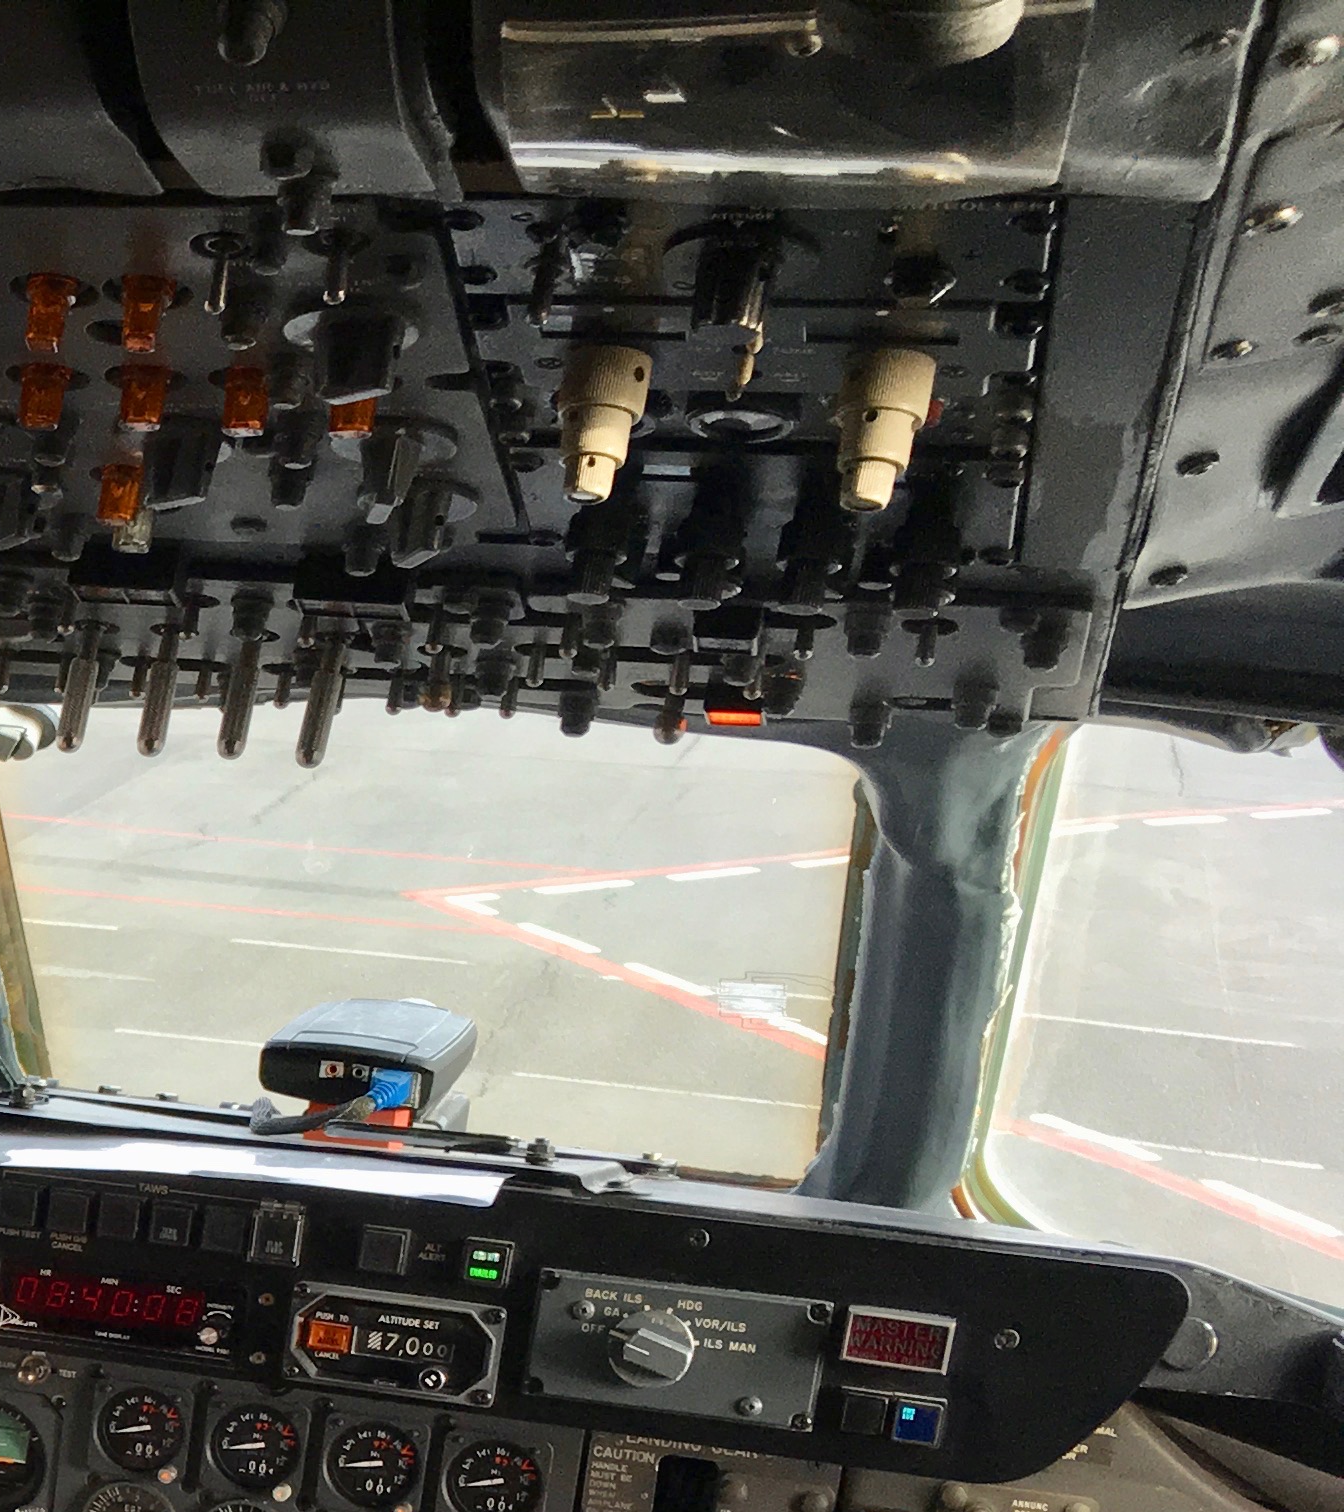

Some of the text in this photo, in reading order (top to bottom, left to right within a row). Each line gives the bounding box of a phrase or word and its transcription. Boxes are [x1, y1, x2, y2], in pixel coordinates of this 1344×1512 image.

[137, 1183, 168, 1195] TAWS
[101, 1277, 118, 1286] MIN
[166, 1285, 181, 1295] SEC
[585, 1288, 642, 1304] BACK ILS
[678, 1300, 703, 1311] HDG
[316, 1312, 333, 1321] PUSH
[604, 1307, 619, 1317] GA
[378, 1314, 440, 1330] ALTITUDE SET
[695, 1318, 746, 1333] VOR/ILS
[581, 1324, 604, 1334] OFF
[857, 1317, 942, 1340] MASTER
[704, 1339, 756, 1354] ILS MAN
[852, 1332, 941, 1358] WARNING
[315, 1351, 339, 1360] CANCEL
[593, 1443, 656, 1464] CAUTION
[1012, 1499, 1049, 1512] ANNUNC
